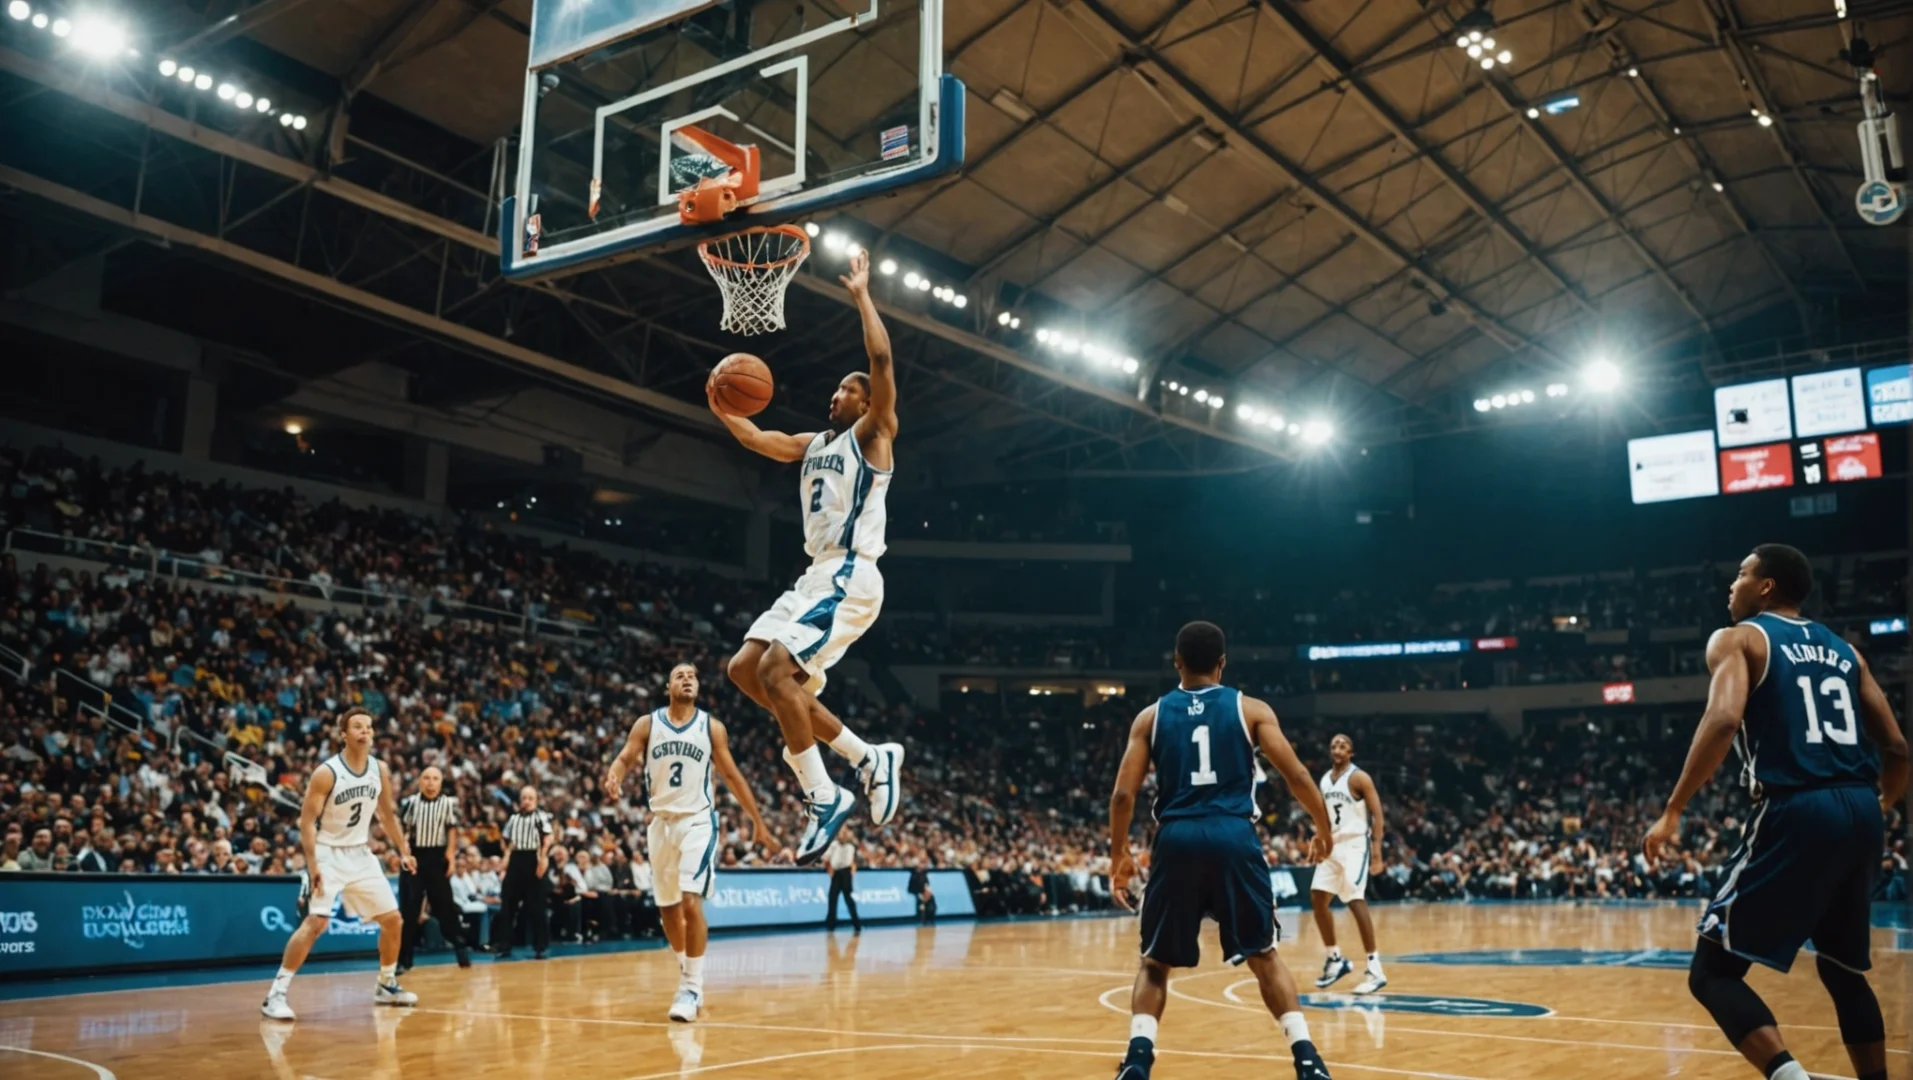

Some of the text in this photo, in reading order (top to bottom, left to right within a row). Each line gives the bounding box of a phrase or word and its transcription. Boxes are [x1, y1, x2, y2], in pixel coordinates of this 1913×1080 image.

[811, 477, 824, 512] 2
[1796, 675, 1857, 745] 13
[1190, 725, 1217, 786] 1
[346, 801, 362, 828] 3
